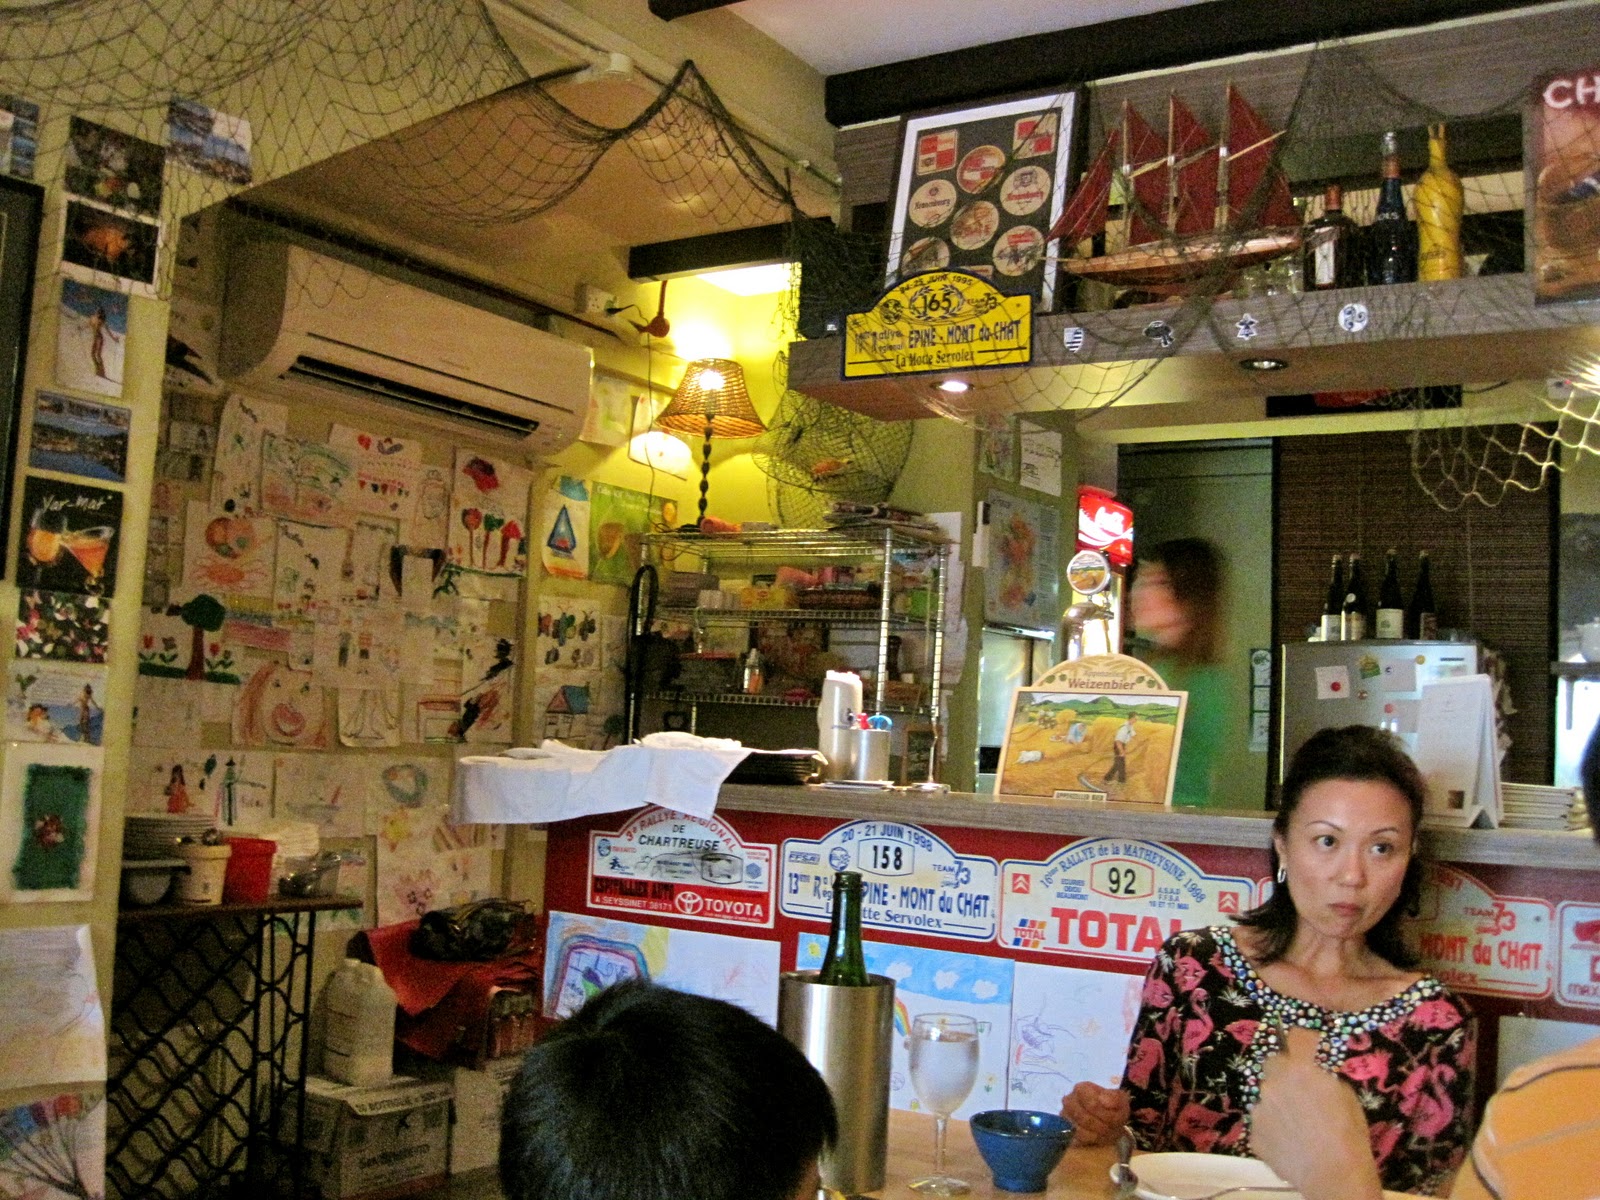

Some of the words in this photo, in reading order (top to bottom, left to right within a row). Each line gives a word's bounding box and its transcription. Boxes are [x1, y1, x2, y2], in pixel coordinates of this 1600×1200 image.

[921, 292, 952, 315] 165
[1068, 678, 1136, 690] Weizenbier
[672, 824, 686, 834] DE
[841, 828, 855, 844] 20
[864, 824, 877, 837] 21
[879, 824, 904, 839] JUIN
[906, 829, 933, 852] 1998
[638, 834, 720, 851] CHARTREUSE
[871, 844, 904, 871] 158
[1059, 846, 1097, 872] RALLYE
[1098, 844, 1110, 856] de
[1123, 843, 1186, 882] MATHEYSINE
[1107, 866, 1137, 895] 92
[704, 897, 764, 918] TOYOTA
[899, 885, 936, 912] MONT
[938, 890, 953, 914] du
[957, 892, 990, 918] CHAT
[884, 909, 944, 929] Servolex
[1013, 926, 1047, 941] TOTAL
[1471, 938, 1493, 966] du
[1497, 940, 1544, 969] CHAT
